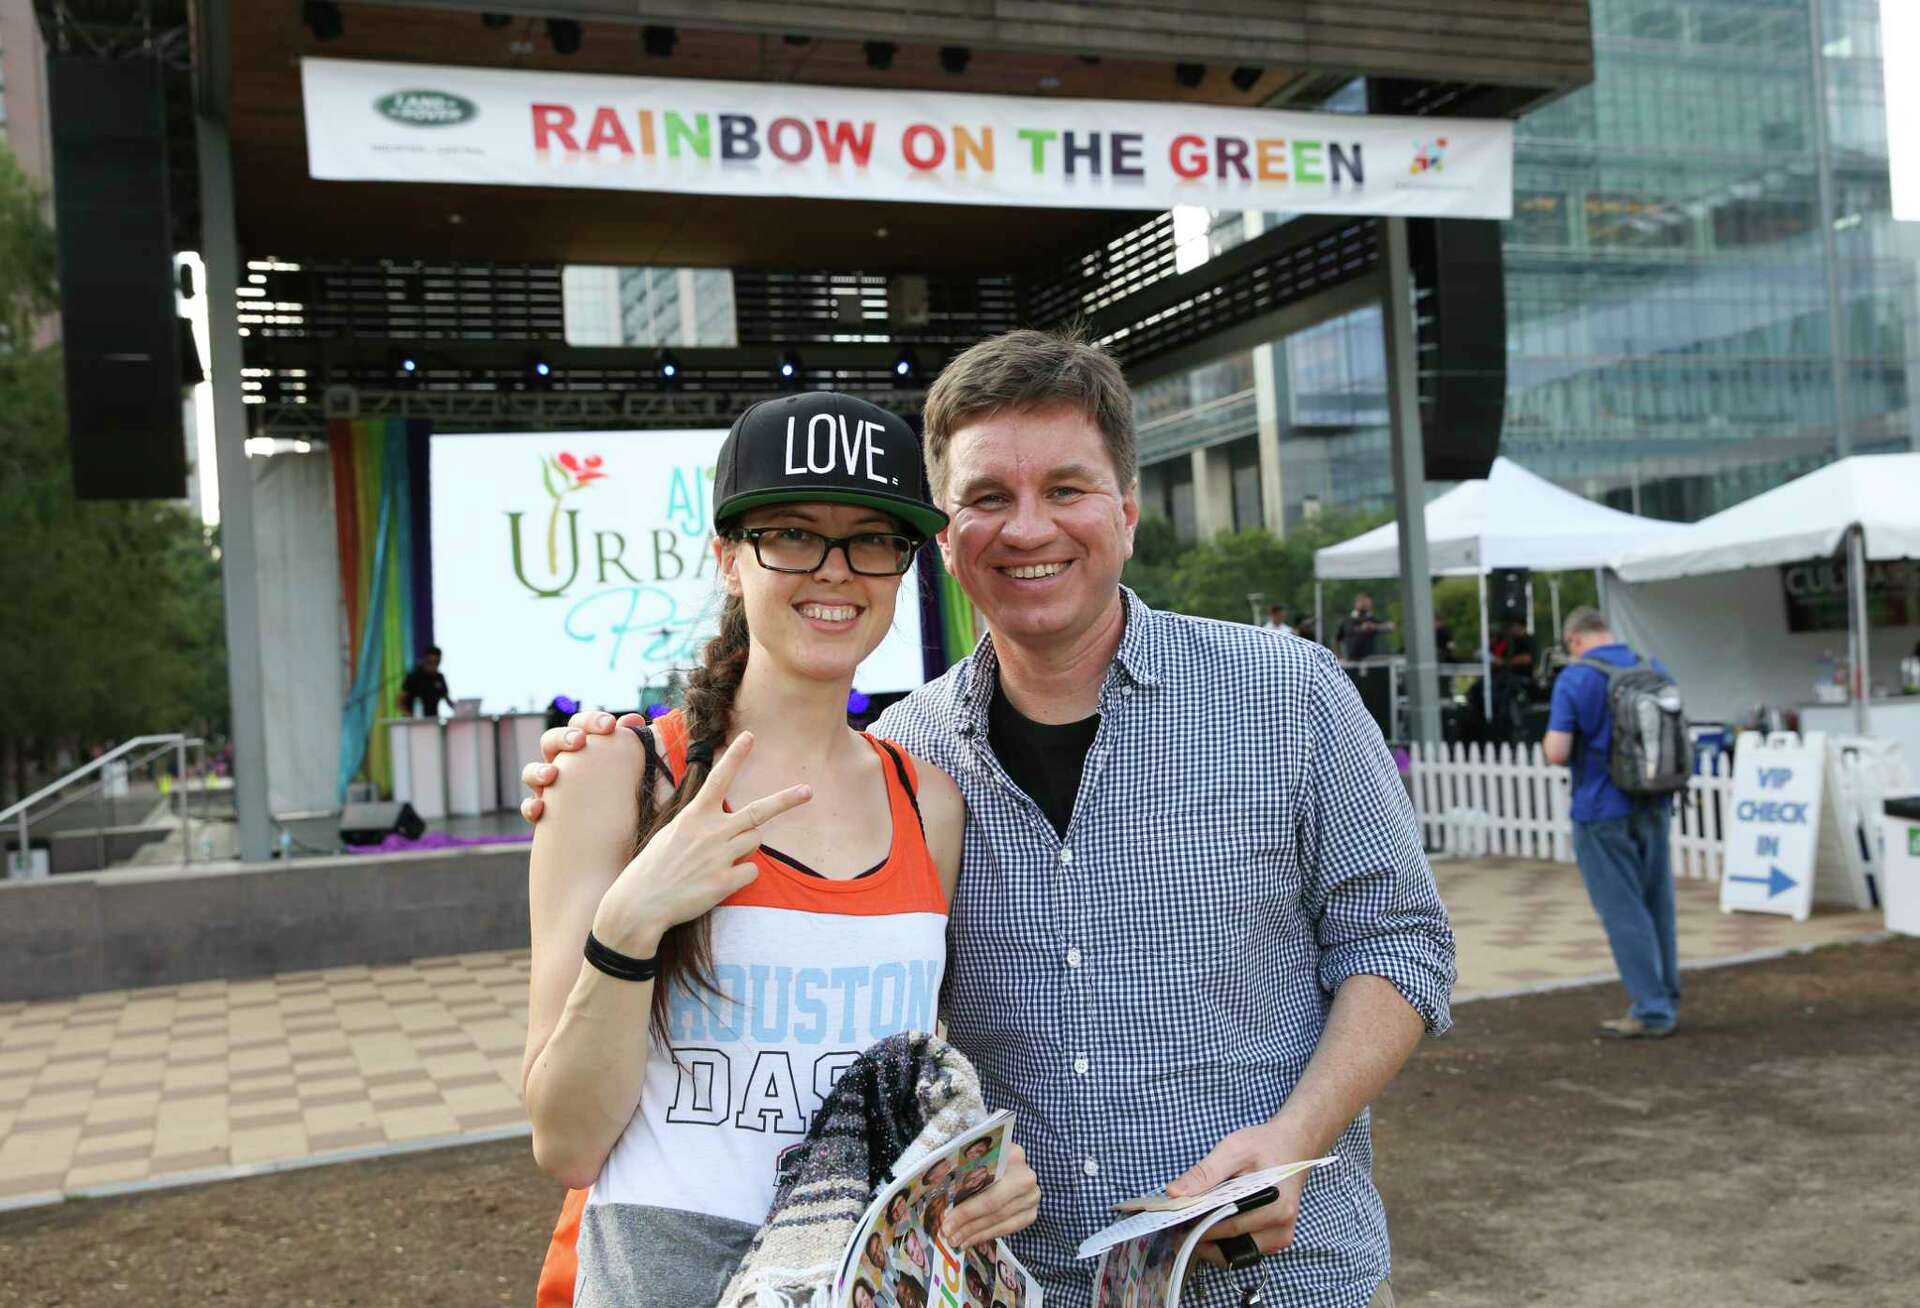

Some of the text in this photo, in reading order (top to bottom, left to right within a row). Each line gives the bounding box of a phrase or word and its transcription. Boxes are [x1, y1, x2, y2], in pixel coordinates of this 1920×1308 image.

[531, 102, 1364, 184] RAINBOW ON THE GREEN
[503, 509, 715, 598] URBA
[1757, 767, 1793, 789] VIP
[1736, 801, 1809, 825] CHECK
[1756, 835, 1779, 857] IN
